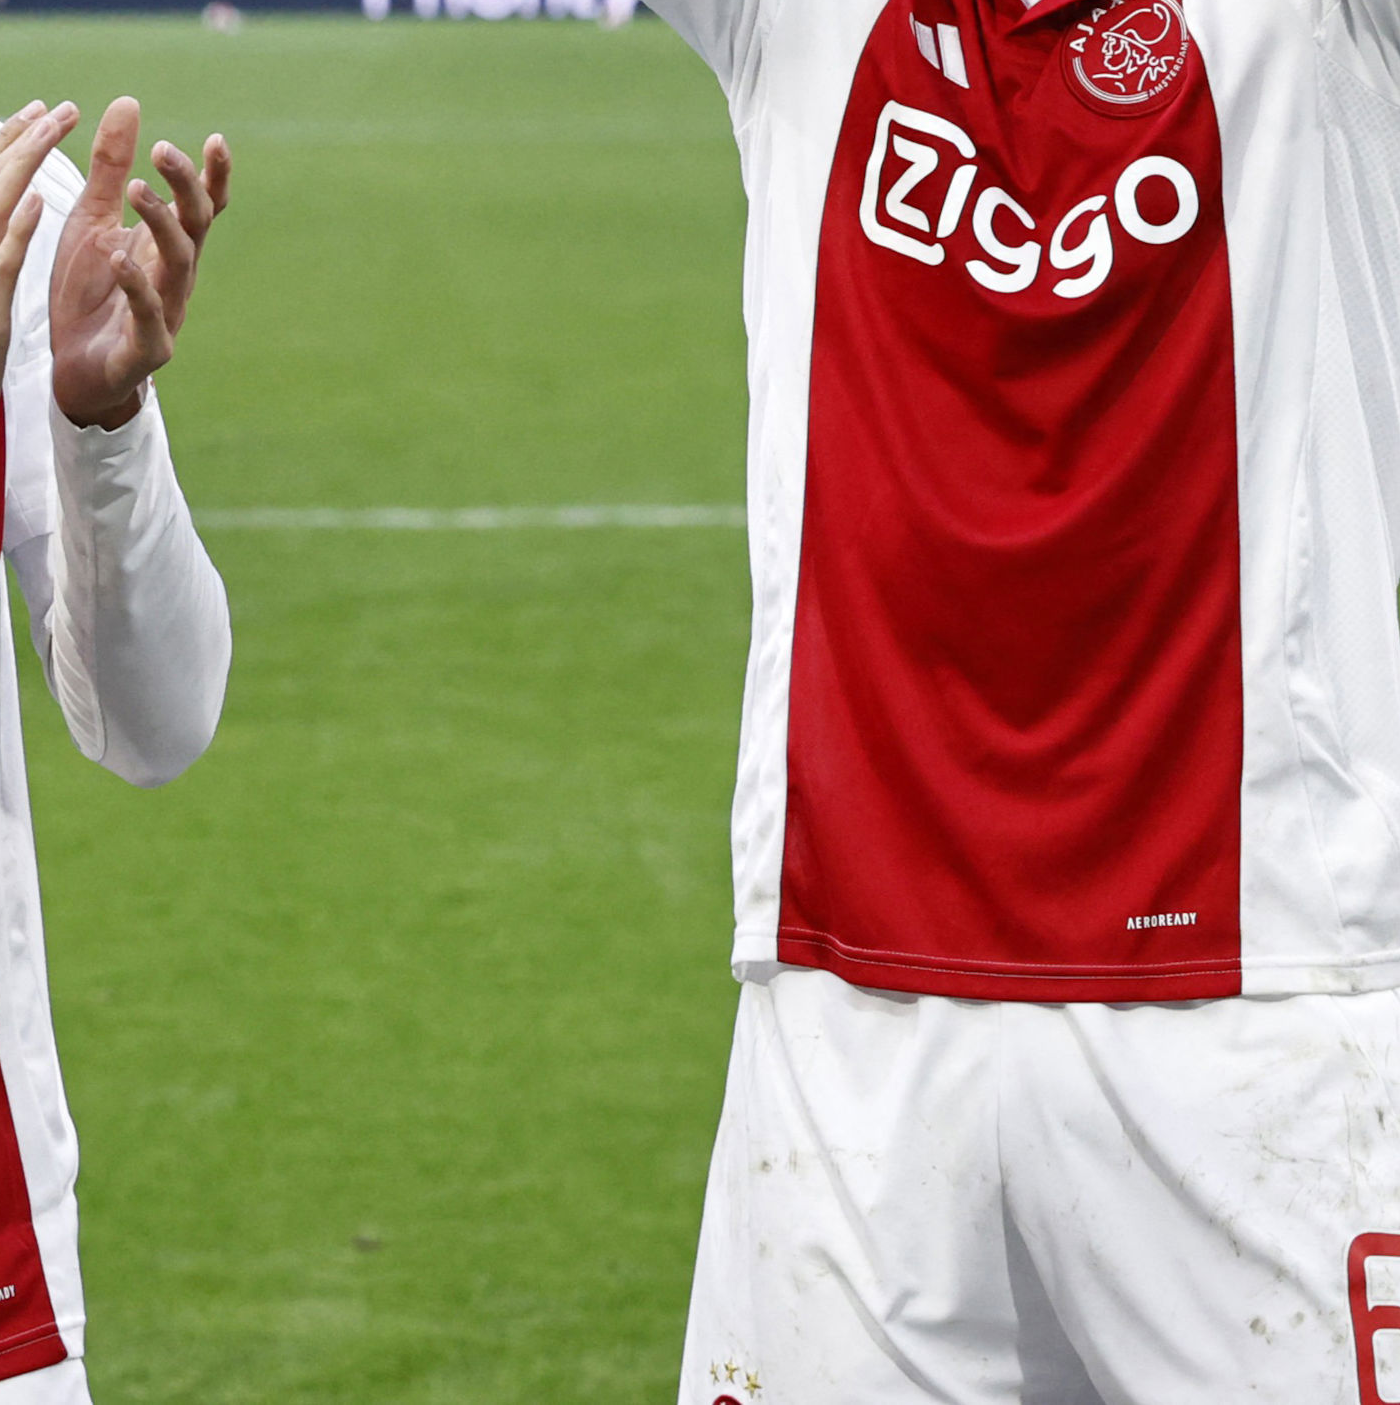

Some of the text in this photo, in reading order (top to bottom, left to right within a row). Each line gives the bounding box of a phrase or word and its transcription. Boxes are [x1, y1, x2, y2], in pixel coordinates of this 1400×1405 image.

[1148, 41, 1189, 98] AMSTERDAM
[859, 100, 1199, 298] Ziggo
[1126, 912, 1197, 930] AEROREADY
